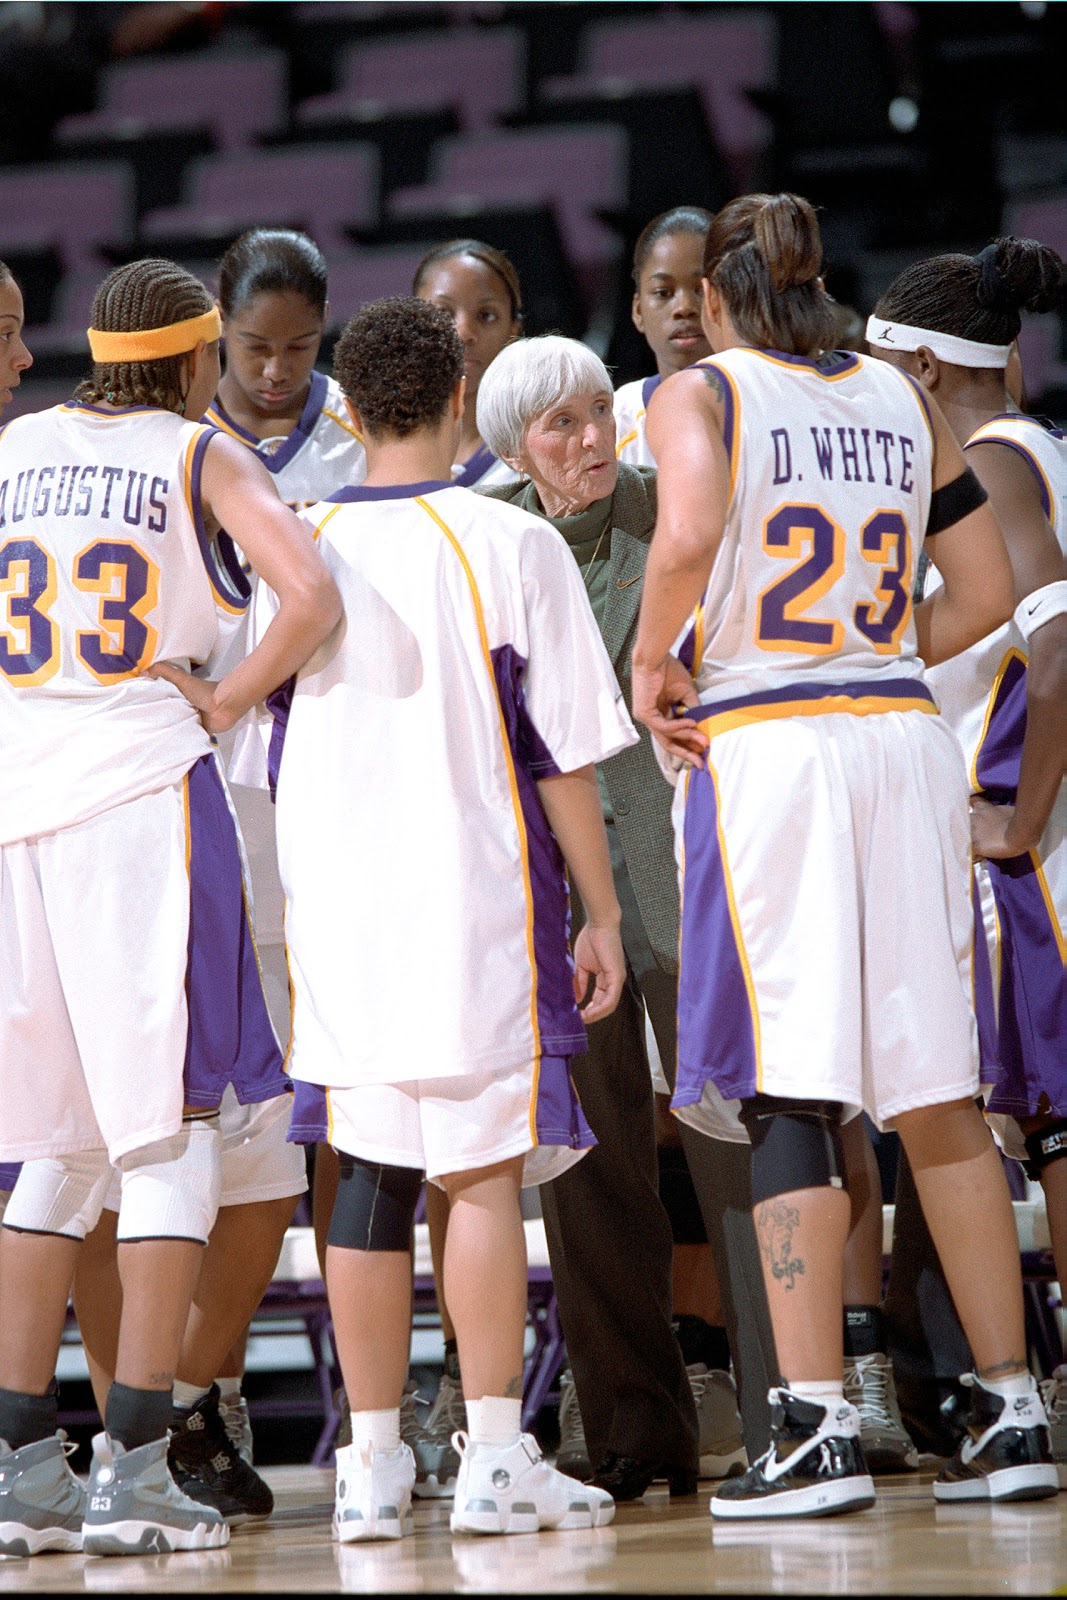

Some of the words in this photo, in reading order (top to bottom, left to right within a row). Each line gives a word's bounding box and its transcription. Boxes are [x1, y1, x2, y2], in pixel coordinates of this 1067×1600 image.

[771, 427, 802, 485] D.
[811, 426, 914, 494] WHITE
[0, 536, 160, 686] 33
[754, 501, 912, 655] 23
[91, 1496, 111, 1511] 23
